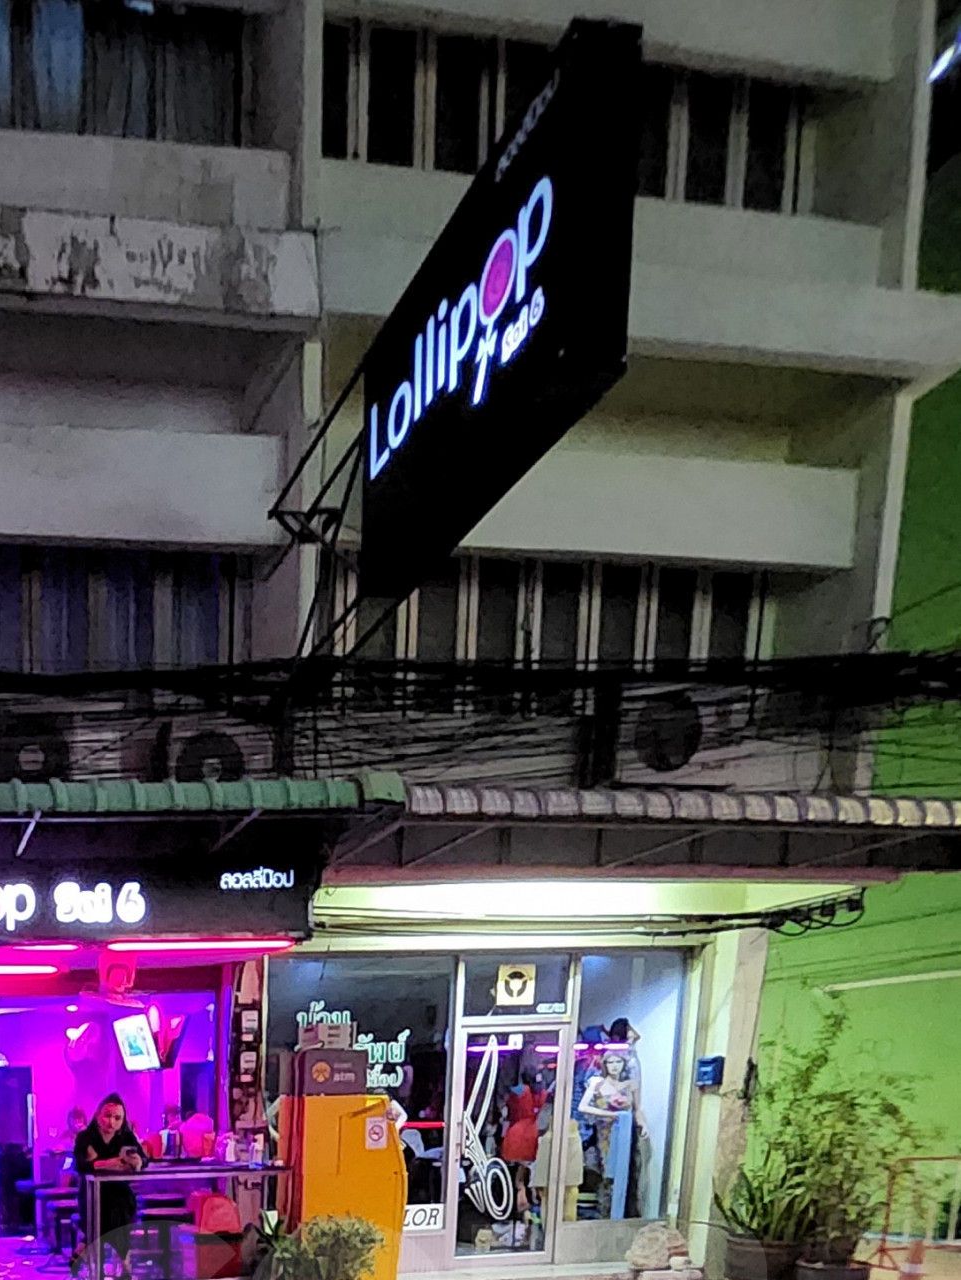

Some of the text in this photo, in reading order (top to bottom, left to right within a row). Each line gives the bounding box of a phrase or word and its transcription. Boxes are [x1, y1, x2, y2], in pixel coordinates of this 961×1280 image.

[370, 175, 554, 481] Lollipop
[501, 285, 545, 364] Soi 6
[53, 881, 113, 923] Soi
[116, 882, 146, 923] 6
[403, 1208, 440, 1227] LOR
